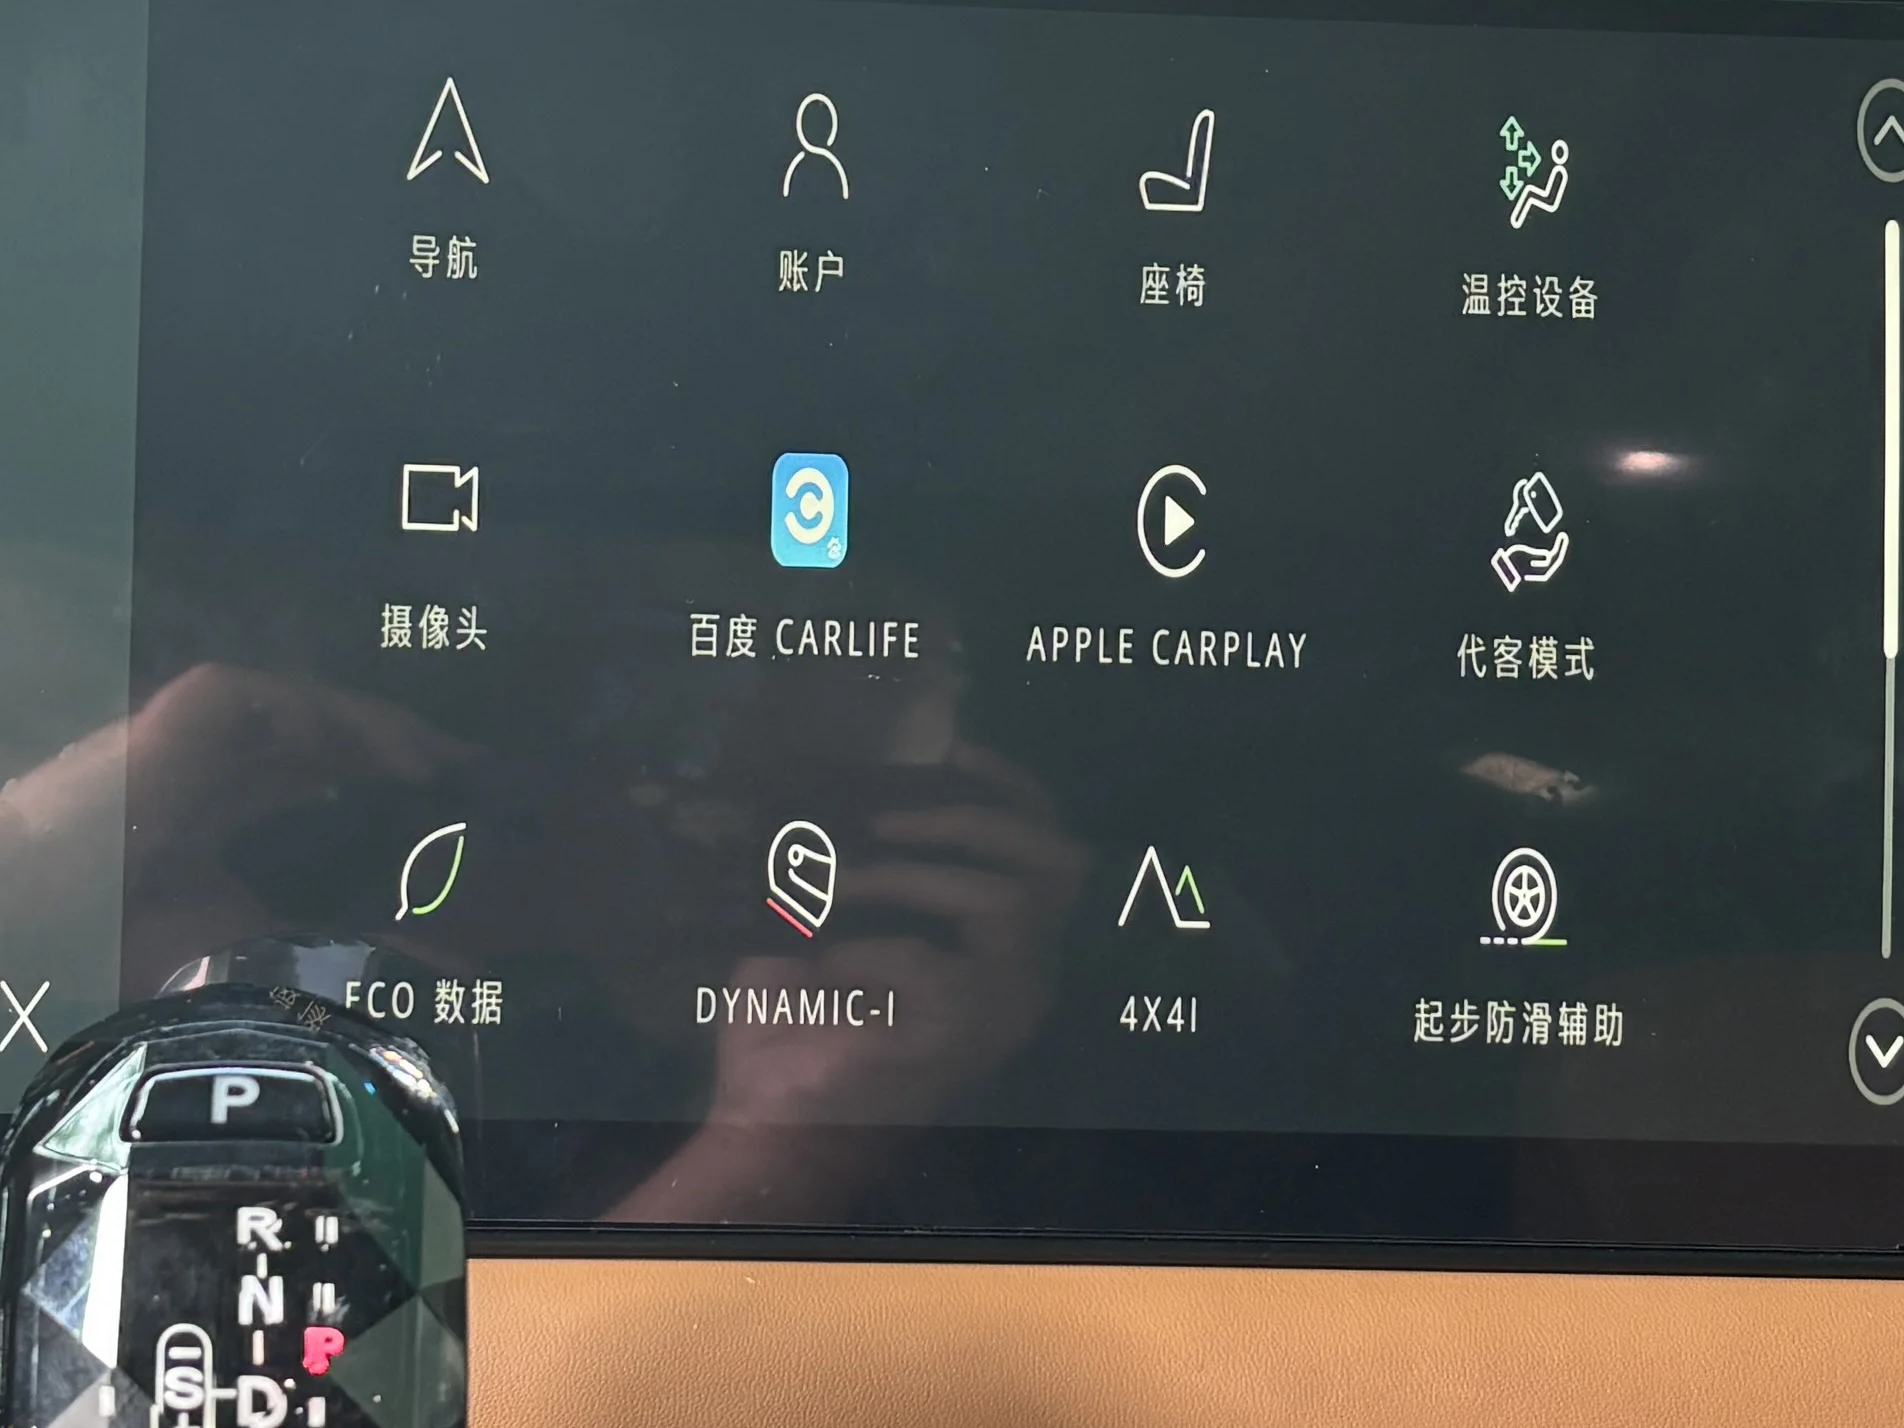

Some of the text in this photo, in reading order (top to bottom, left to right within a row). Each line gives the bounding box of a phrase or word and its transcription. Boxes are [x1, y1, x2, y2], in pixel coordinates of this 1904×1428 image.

[409, 234, 478, 280] 导航
[778, 249, 844, 293] 账户
[1140, 262, 1206, 308] 座椅
[1462, 272, 1598, 320] 温控设备
[380, 602, 488, 652] 摄像头
[689, 613, 920, 659] 百度 CARLIFE
[1026, 625, 1308, 670] APPLE CARPLAY
[1457, 633, 1595, 681] 代客模式
[344, 980, 415, 1020] ECO
[433, 978, 504, 1025] 数据
[696, 986, 895, 1028] DYNAMIC-I
[1119, 995, 1197, 1034] 4X4I
[1413, 997, 1624, 1047] 起步防滑辅助
[210, 1075, 260, 1124] P
[237, 1206, 284, 1252] R
[238, 1274, 284, 1325] N
[303, 1327, 345, 1375] P
